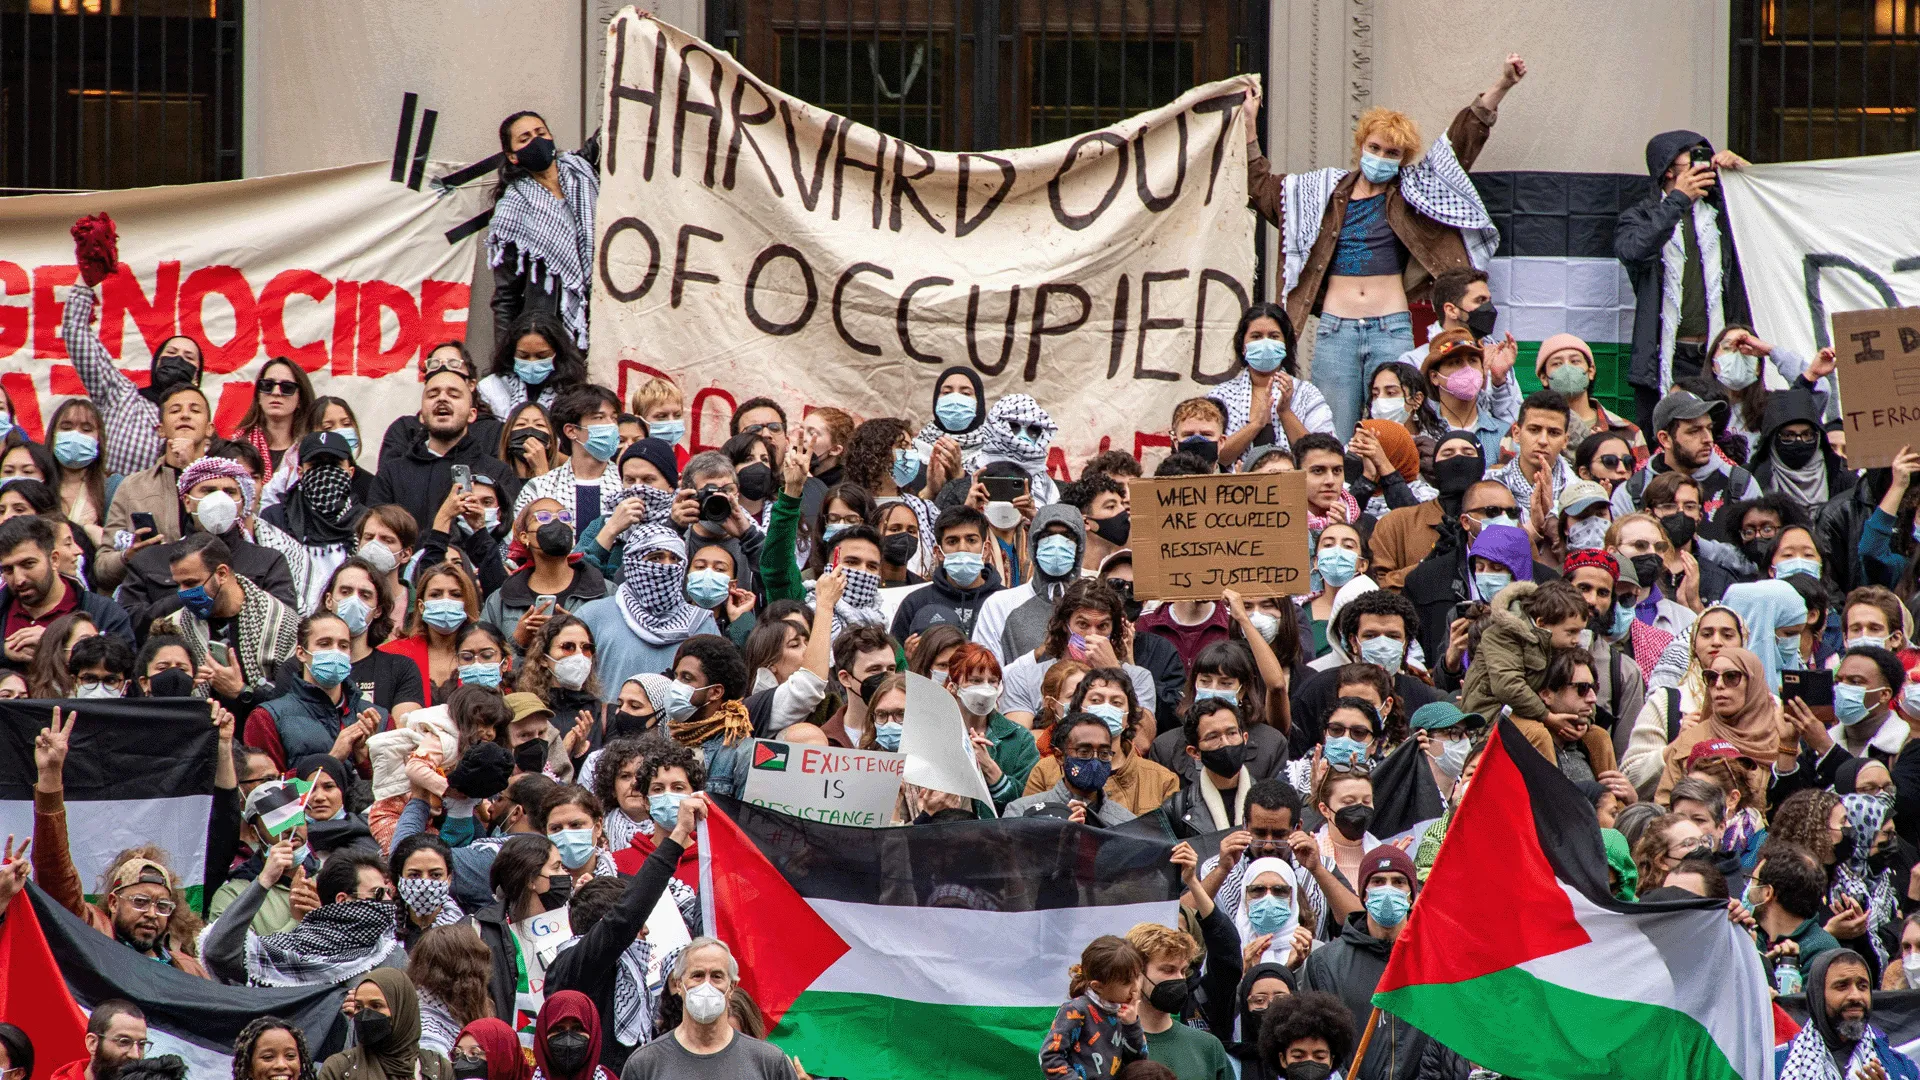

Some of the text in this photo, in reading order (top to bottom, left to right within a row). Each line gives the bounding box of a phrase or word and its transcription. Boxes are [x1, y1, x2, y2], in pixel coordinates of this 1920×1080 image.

[605, 17, 1248, 237] HARVARD OUT
[600, 217, 1250, 384] OF OCCUPIED
[1156, 484, 1279, 507] WHEN PEOPLE
[1162, 511, 1290, 529] ARE OCCUPIED
[1160, 540, 1265, 560] RESISTANCE
[1169, 565, 1299, 588] IS JUSTIFIED
[801, 749, 905, 776] EXISTENCE
[823, 779, 845, 799] IS
